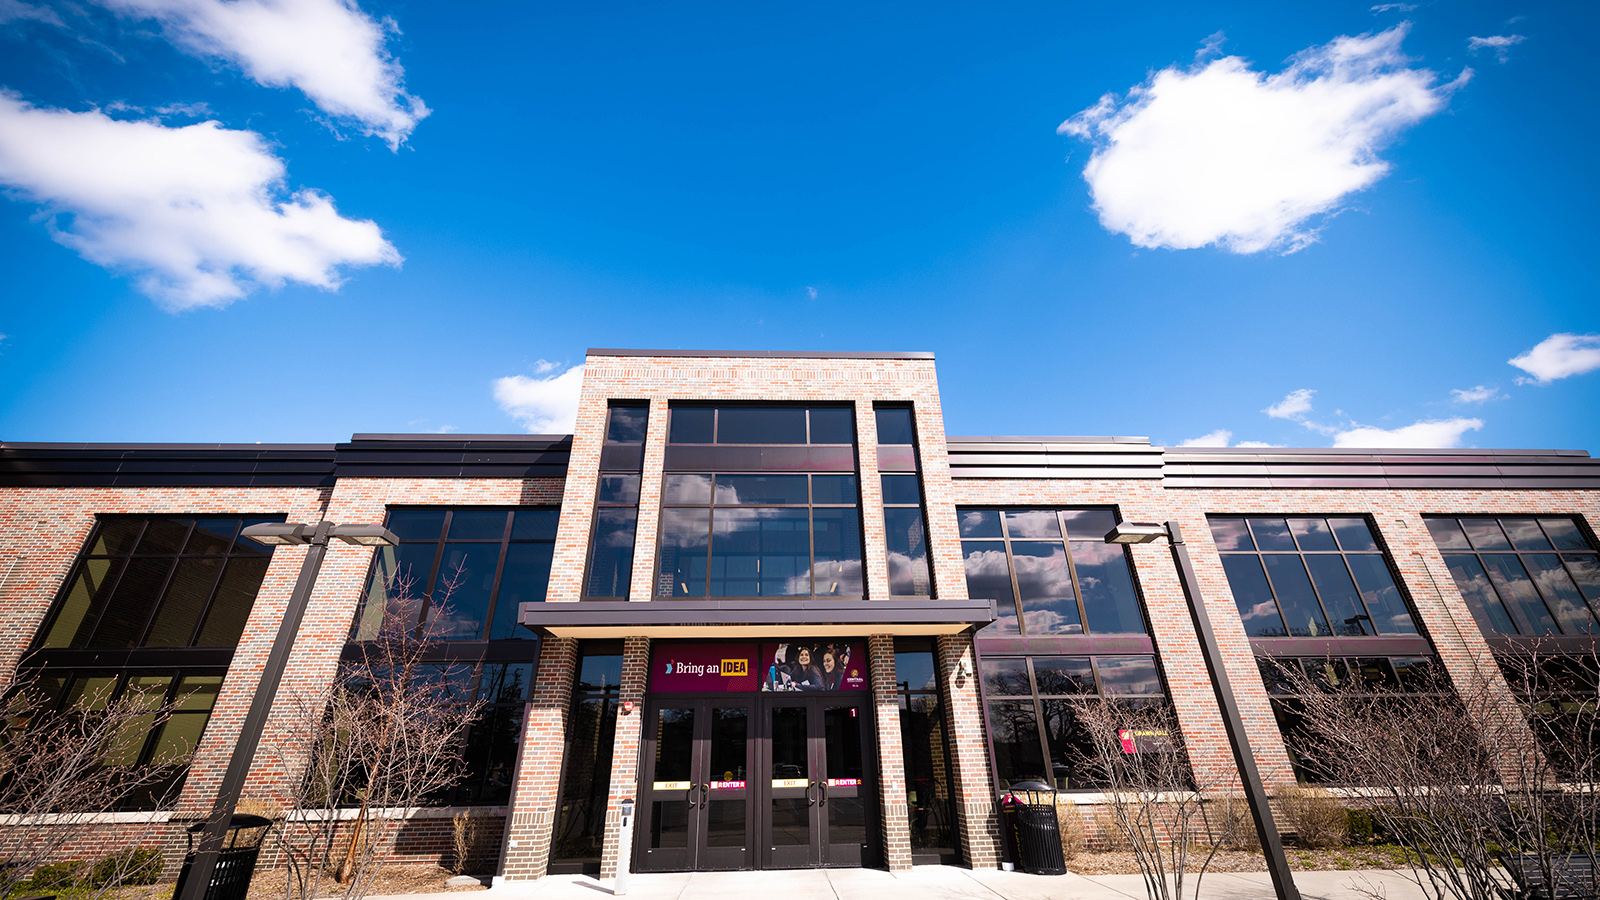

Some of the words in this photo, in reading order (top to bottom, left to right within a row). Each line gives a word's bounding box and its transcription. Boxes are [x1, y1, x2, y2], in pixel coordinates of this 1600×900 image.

[676, 662, 705, 677] Bring
[706, 664, 720, 674] an
[722, 661, 746, 673] IDEA
[851, 708, 856, 717] 1
